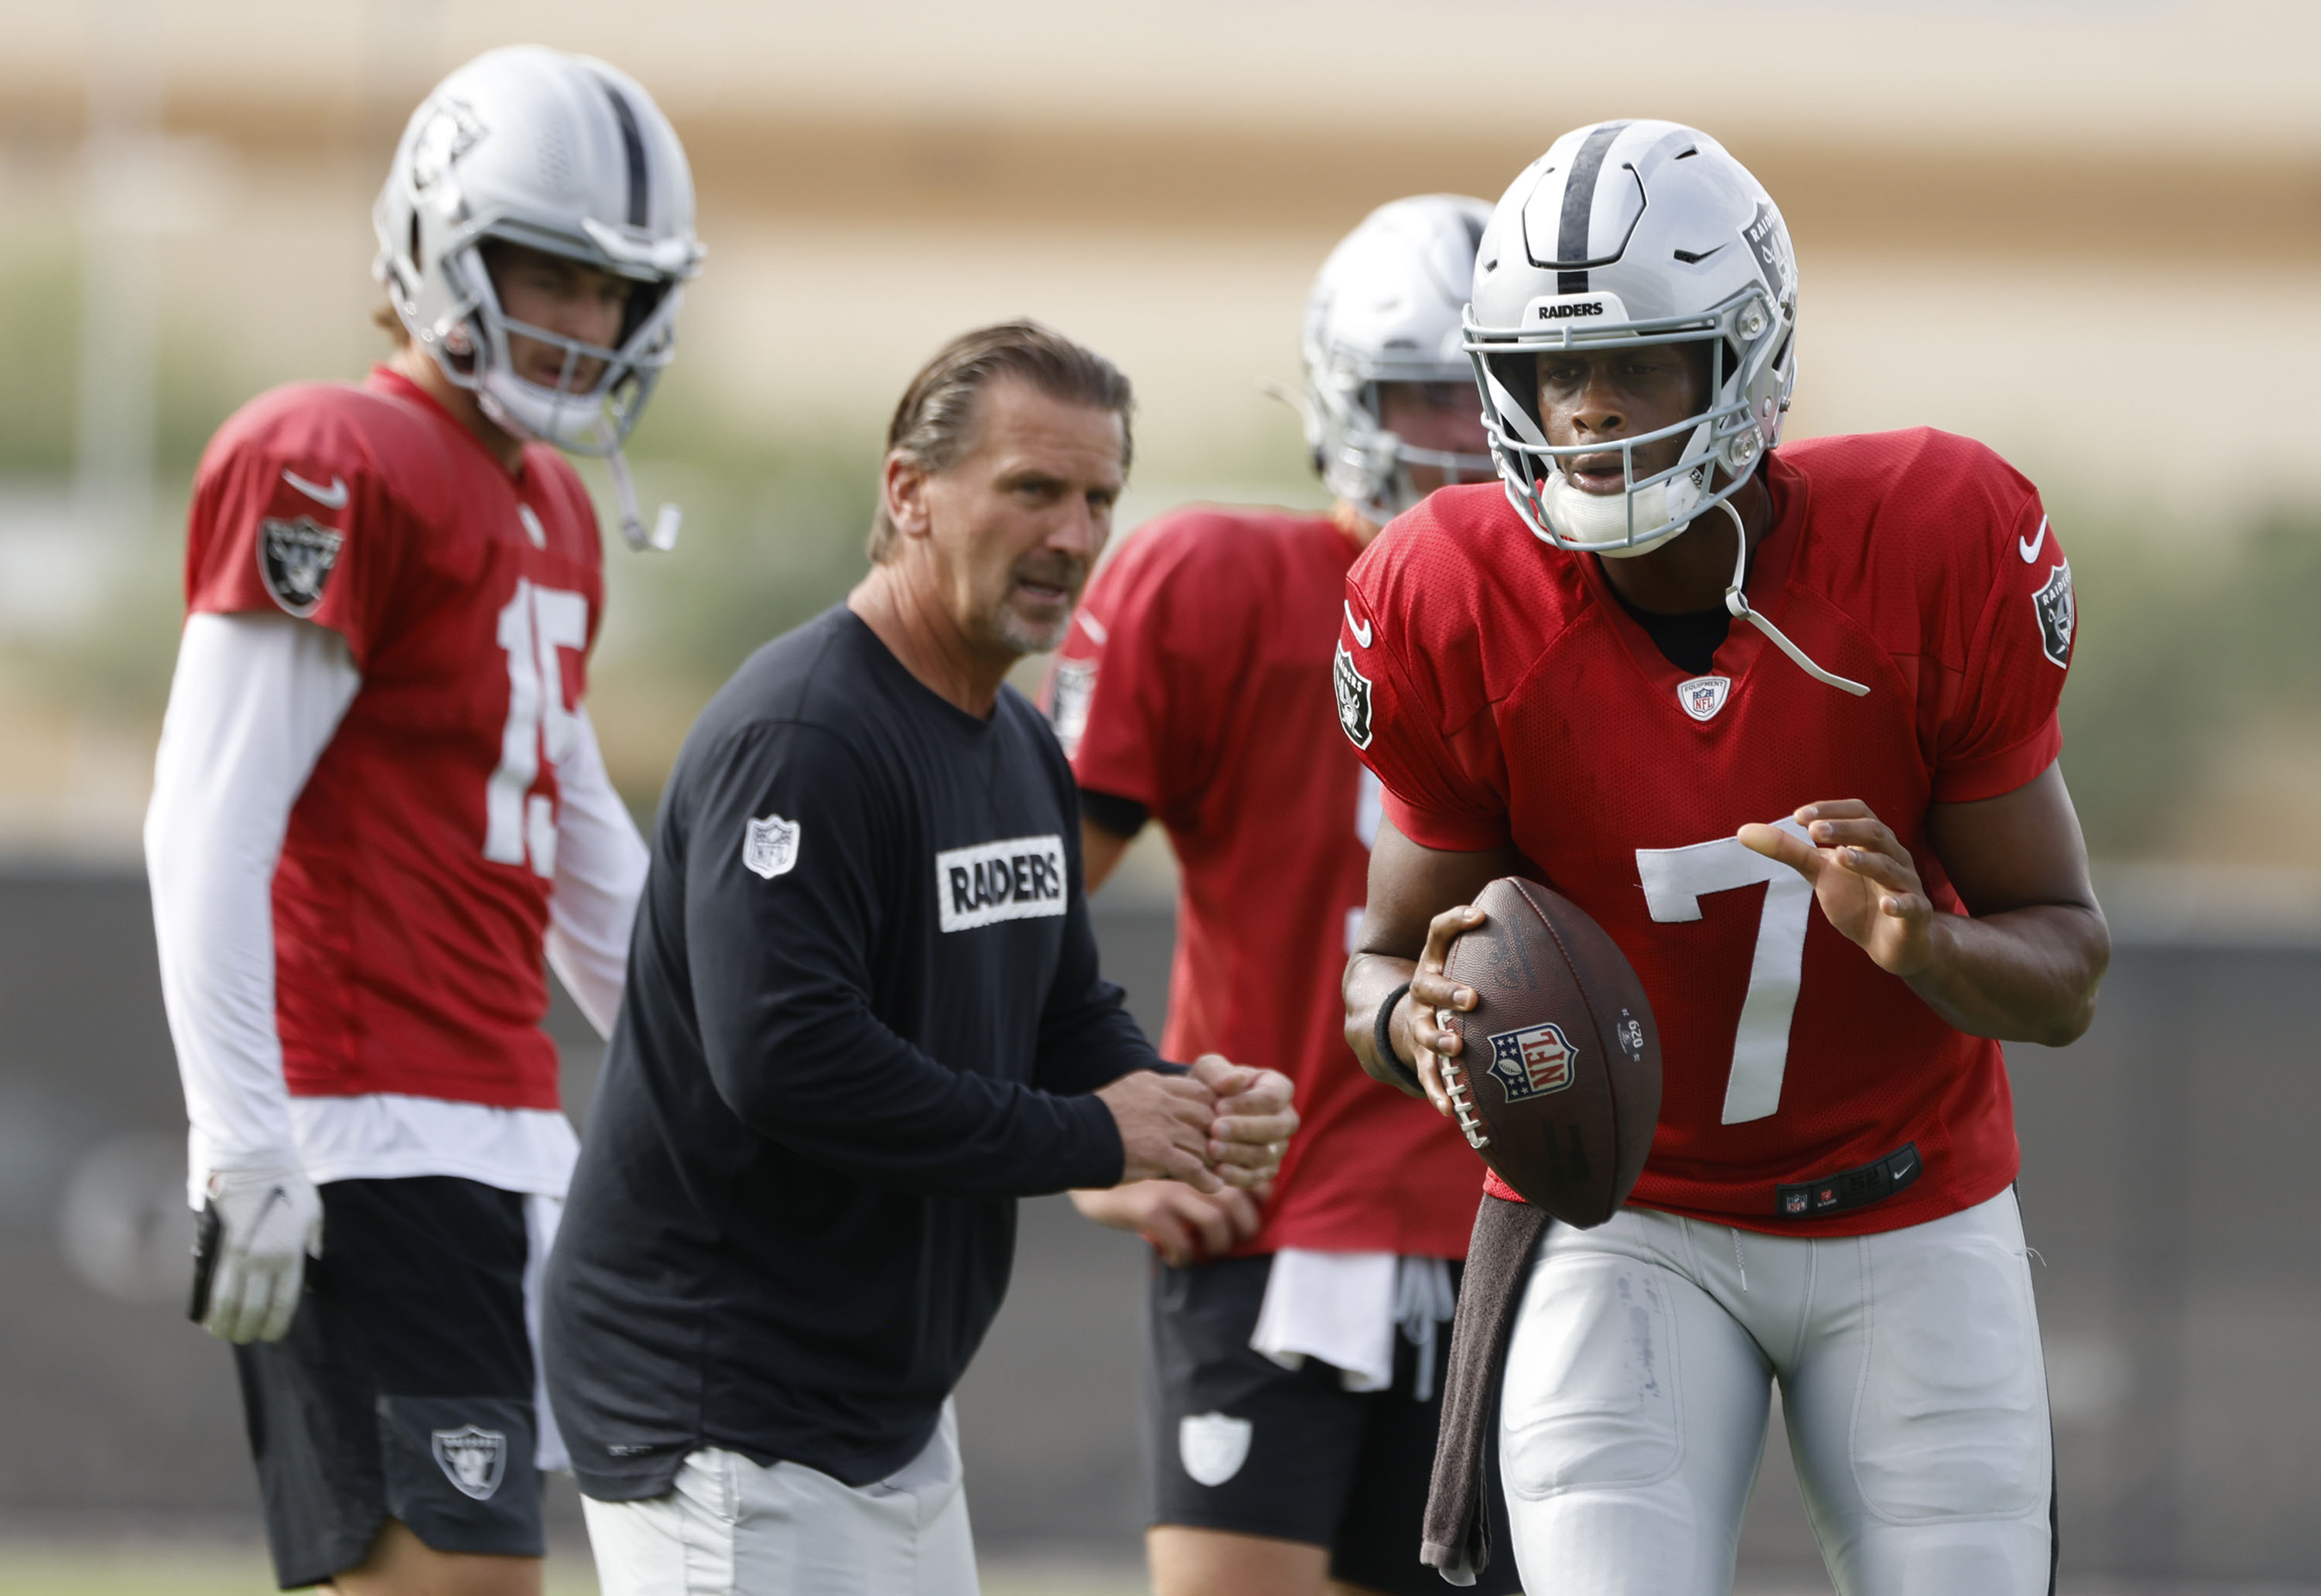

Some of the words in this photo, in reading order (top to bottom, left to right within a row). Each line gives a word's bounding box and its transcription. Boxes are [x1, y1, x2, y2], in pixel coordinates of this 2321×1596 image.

[1539, 302, 1603, 320] RAIDERS
[1684, 681, 1724, 692] EQUIPMENT
[1695, 698, 1713, 710] NFL
[949, 852, 1059, 914] RAIDERS
[1636, 815, 1816, 1126] 7
[1522, 1030, 1565, 1088] NFL
